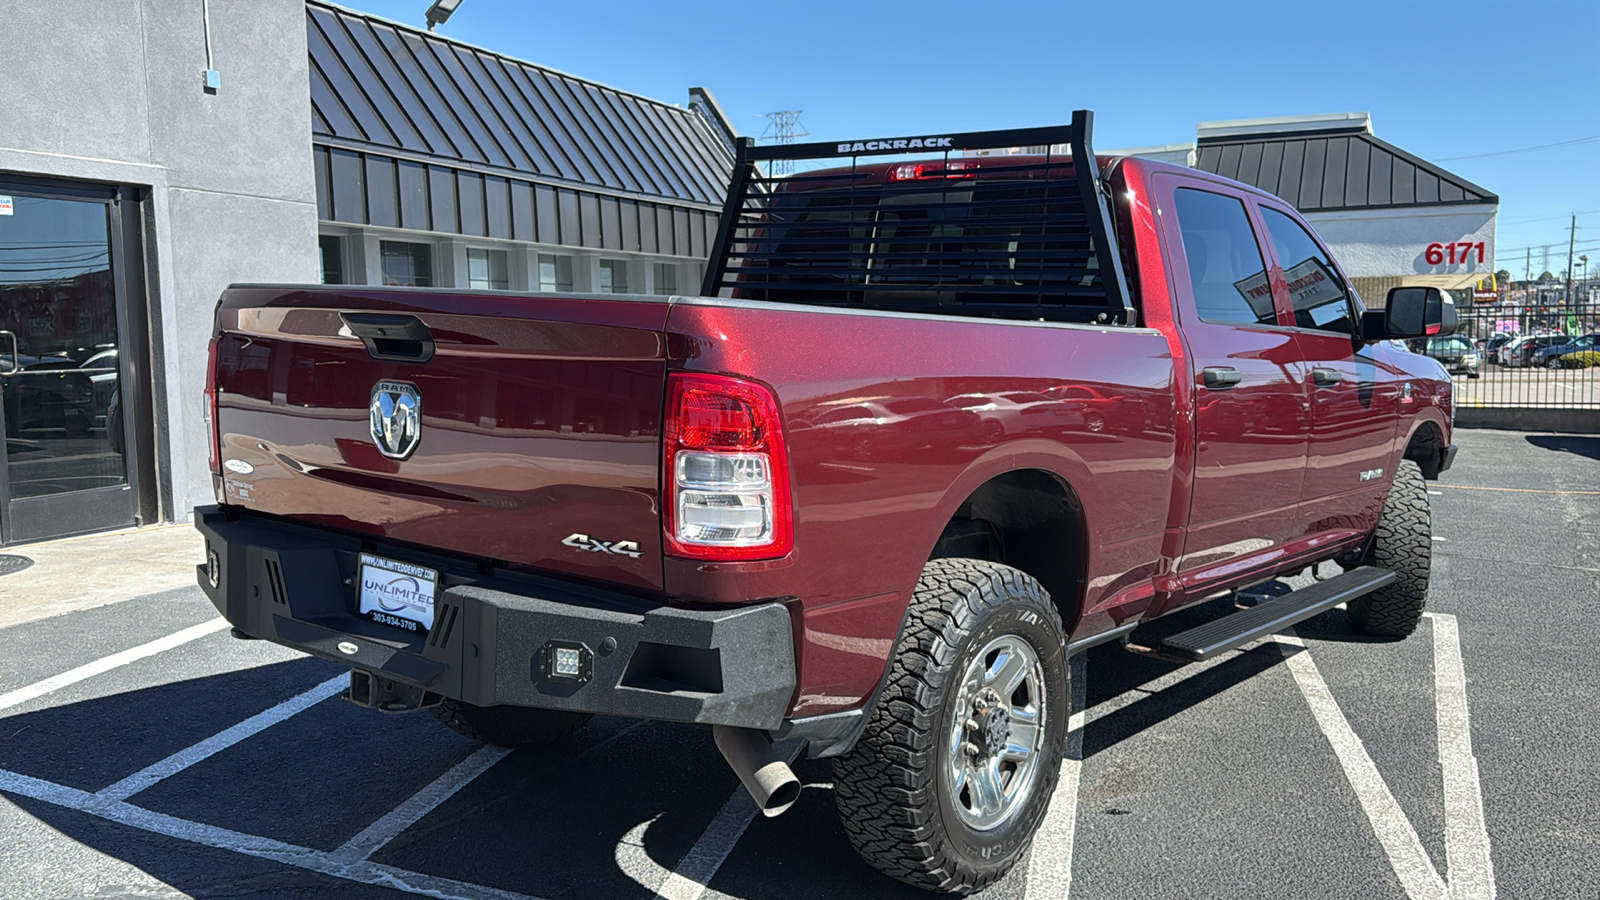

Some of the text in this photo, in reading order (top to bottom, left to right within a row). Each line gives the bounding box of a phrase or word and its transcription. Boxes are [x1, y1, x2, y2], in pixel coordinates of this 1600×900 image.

[837, 137, 952, 153] BACKRACK
[1425, 241, 1486, 266] 6171
[380, 383, 409, 393] RAM
[364, 580, 435, 605] UNLIMITED
[372, 612, 417, 631] 303-934-3705
